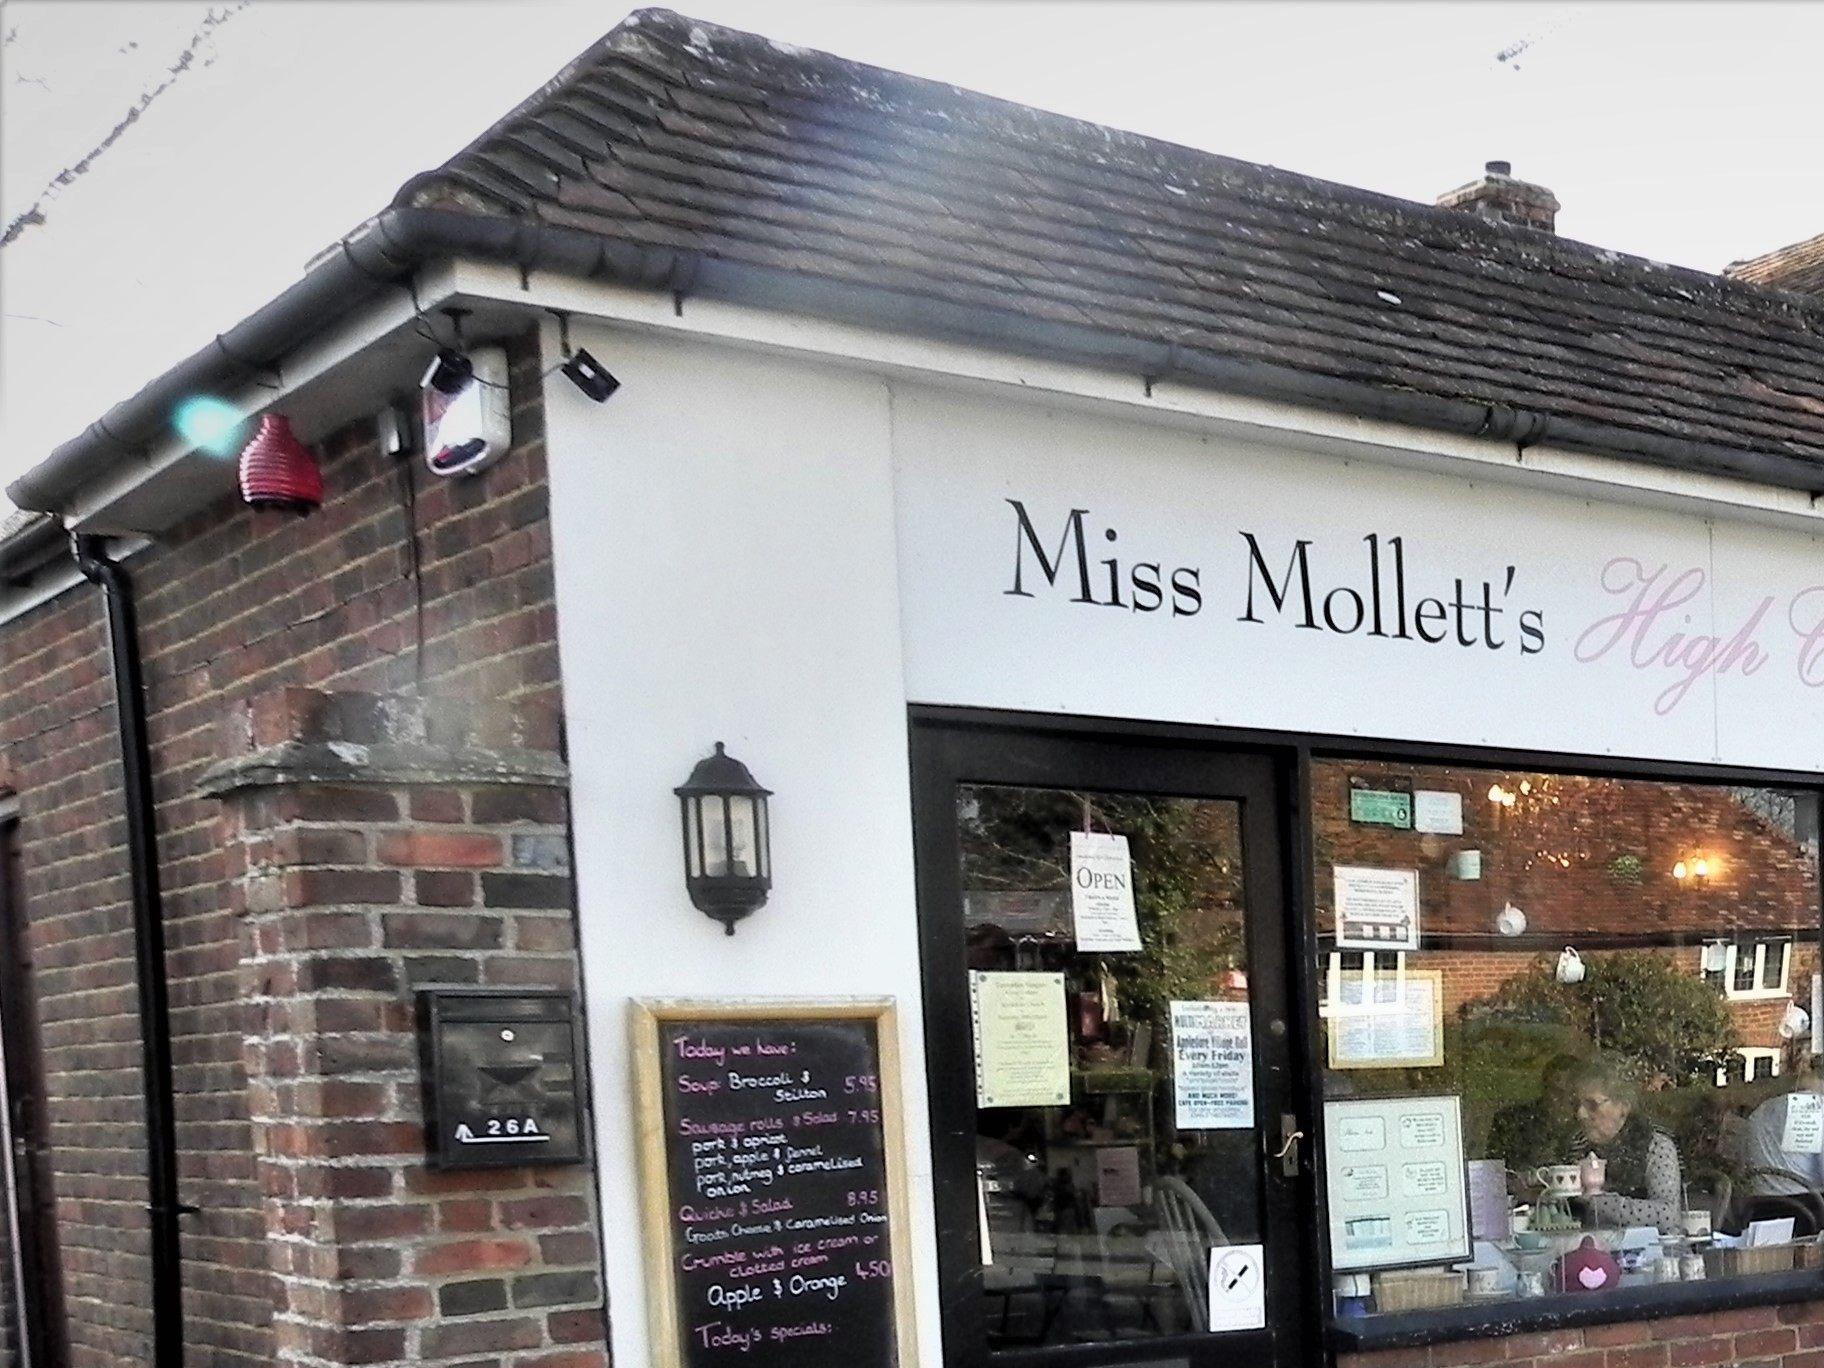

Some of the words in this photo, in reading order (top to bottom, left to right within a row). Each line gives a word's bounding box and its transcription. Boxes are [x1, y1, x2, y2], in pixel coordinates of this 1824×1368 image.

[1003, 498, 1202, 618] Miss
[1237, 531, 1545, 655] Mollett's
[1573, 557, 1774, 716] High
[673, 1034, 726, 1067] Today
[731, 1045, 751, 1056] we
[757, 1037, 796, 1056] have:
[1178, 1049, 1208, 1062] Every
[1211, 1050, 1245, 1063] Friday
[728, 1071, 794, 1090] Broccoli
[843, 1075, 878, 1094] 5.95
[773, 1088, 828, 1103] Stilton
[486, 1118, 539, 1134] 26A
[679, 1118, 746, 1139] Sausage
[750, 1116, 785, 1131] rolls
[802, 1110, 838, 1126] Salad
[691, 1138, 727, 1157] pork
[743, 1133, 789, 1149] apricot
[733, 1153, 769, 1169] apple
[785, 1145, 824, 1162] fennel
[732, 1168, 774, 1186] nutmeg
[706, 1183, 751, 1198] onion
[678, 1204, 735, 1223] Quiche
[751, 1198, 794, 1214] Salad
[859, 1211, 888, 1223] Onion
[681, 1250, 748, 1271] Crumble
[752, 1246, 784, 1262] with
[793, 1241, 812, 1254] ice
[817, 1235, 859, 1250] cream
[863, 1234, 879, 1245] or
[729, 1261, 785, 1278] clotted
[791, 1254, 828, 1268] cream
[789, 1274, 847, 1301] Orange
[695, 1321, 762, 1352] Today's
